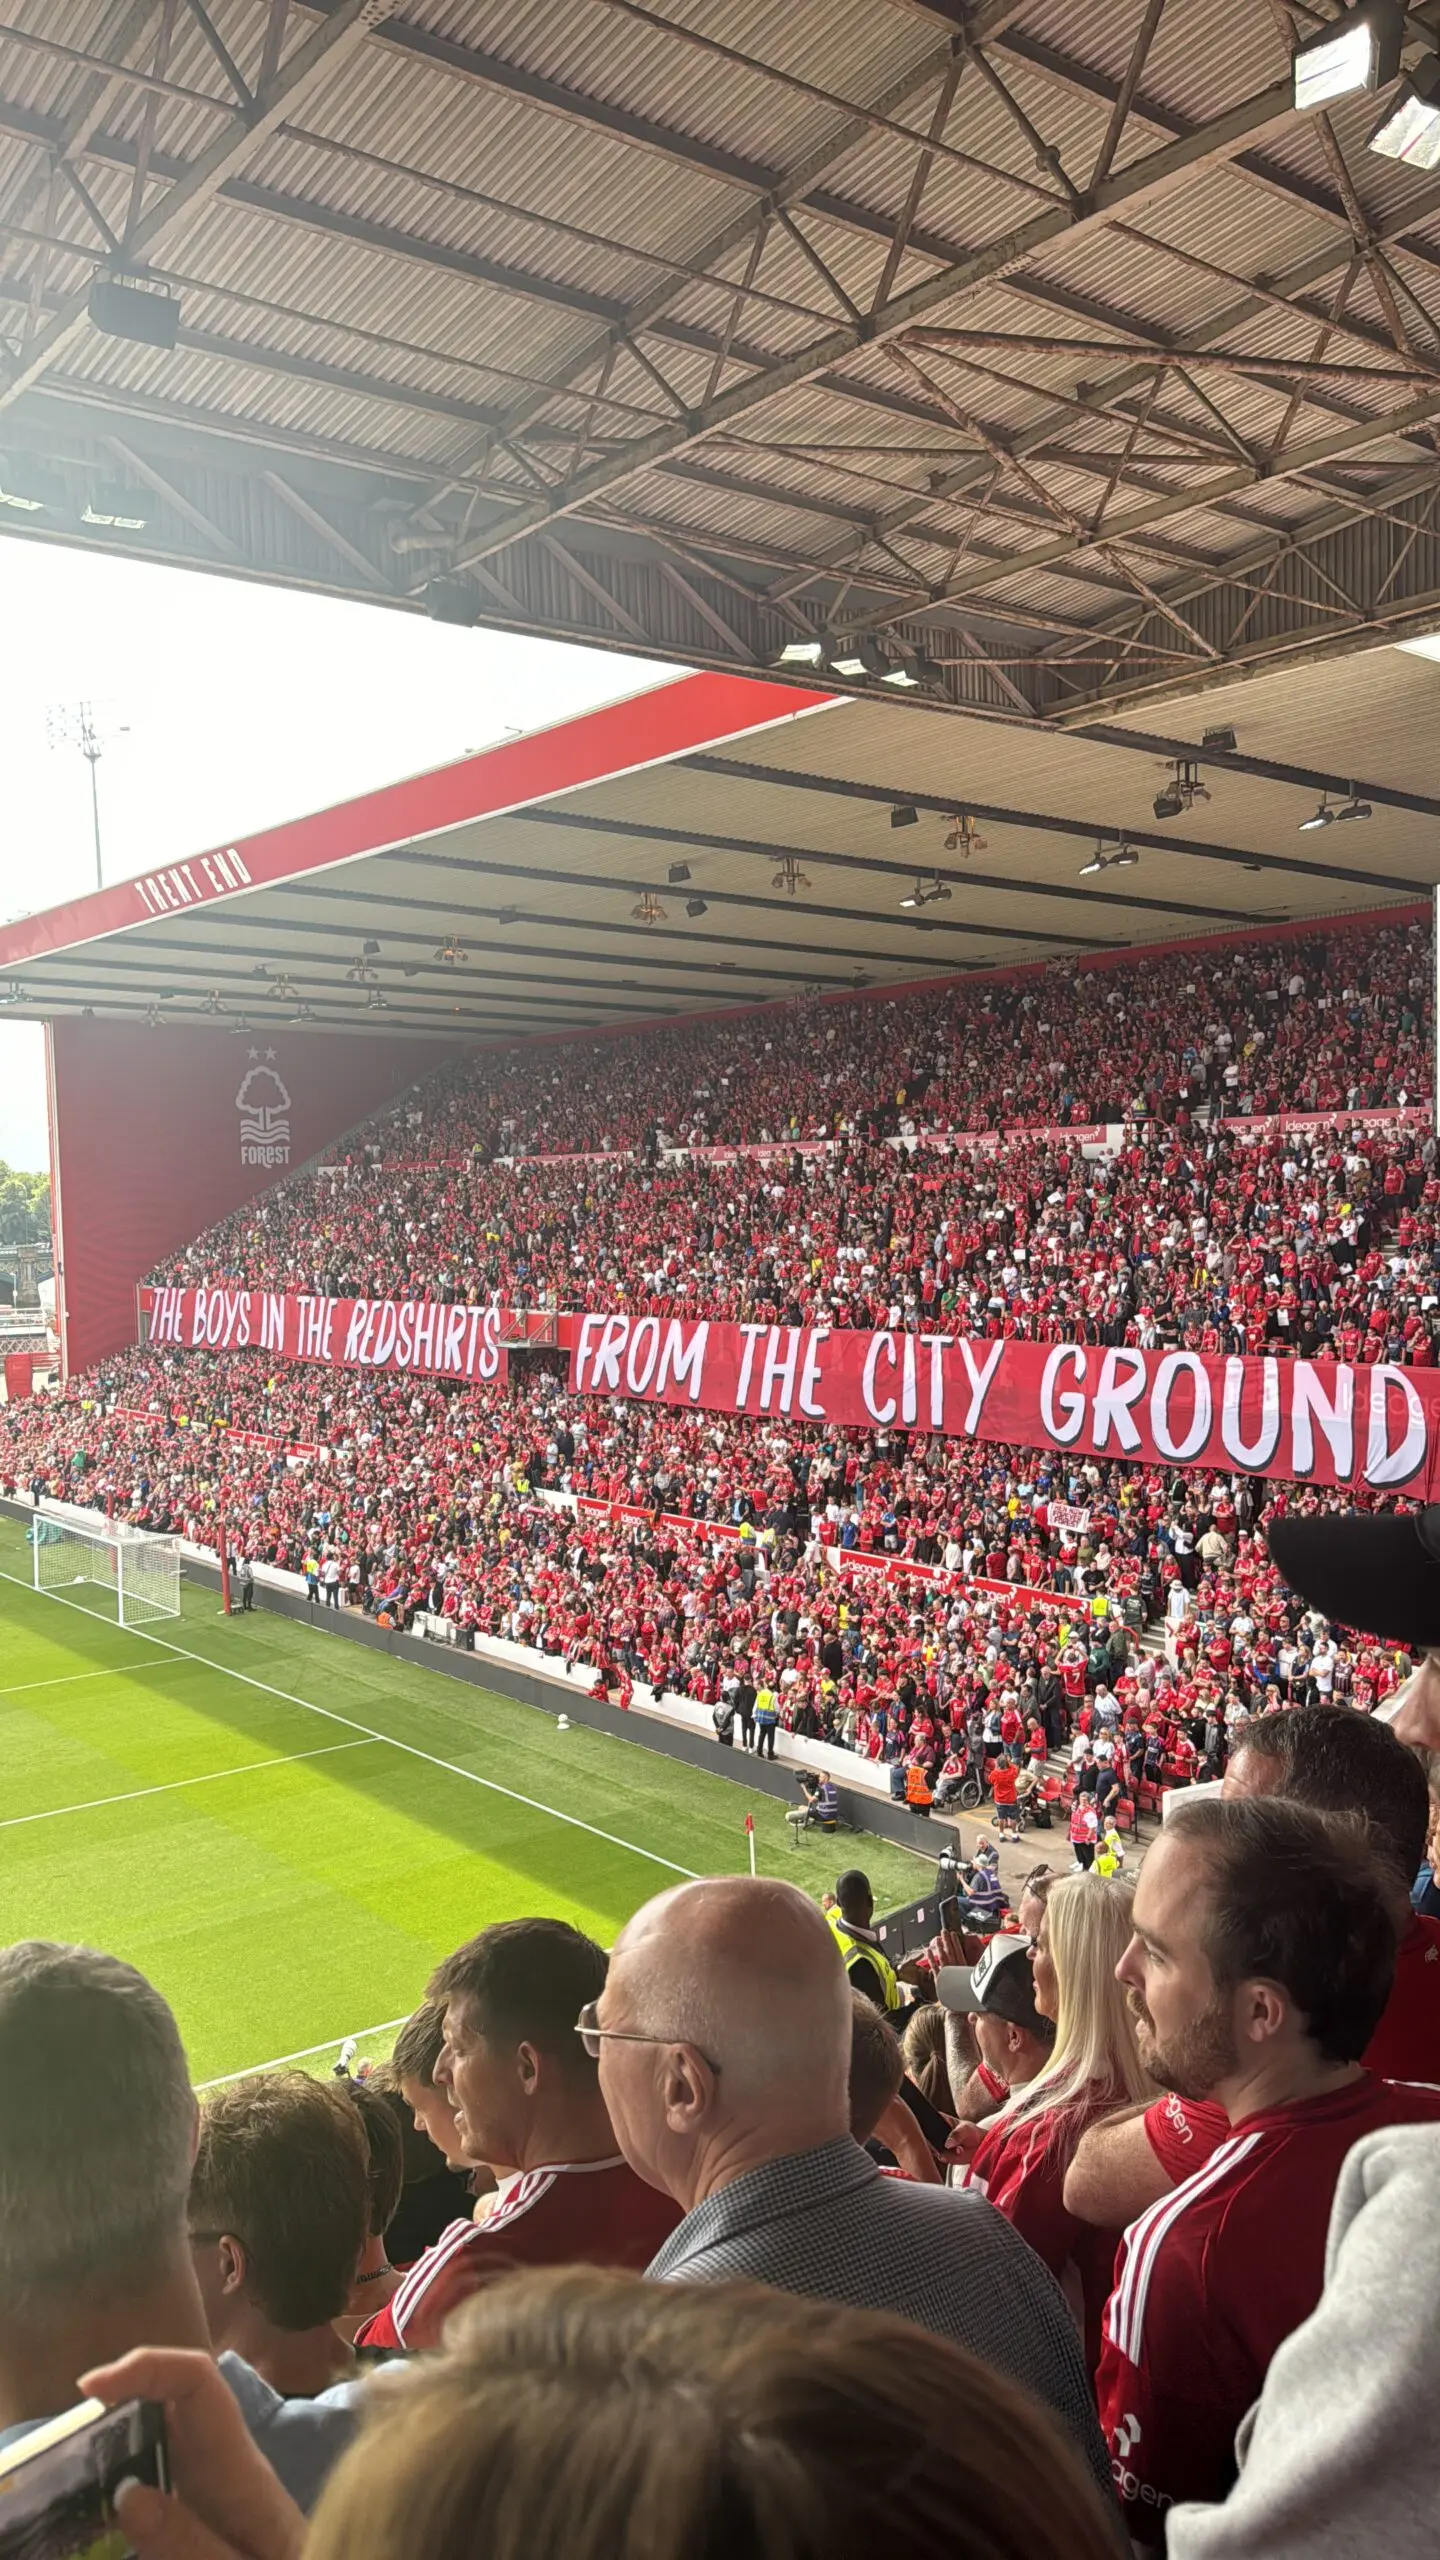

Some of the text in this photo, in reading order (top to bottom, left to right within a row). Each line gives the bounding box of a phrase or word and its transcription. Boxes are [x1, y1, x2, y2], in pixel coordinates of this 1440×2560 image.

[134, 848, 252, 914] TRENT END
[149, 1287, 501, 1381] THE BOYS IN THE REDSHIRTS
[575, 1314, 1427, 1490] FROM THE CITY GROUND
